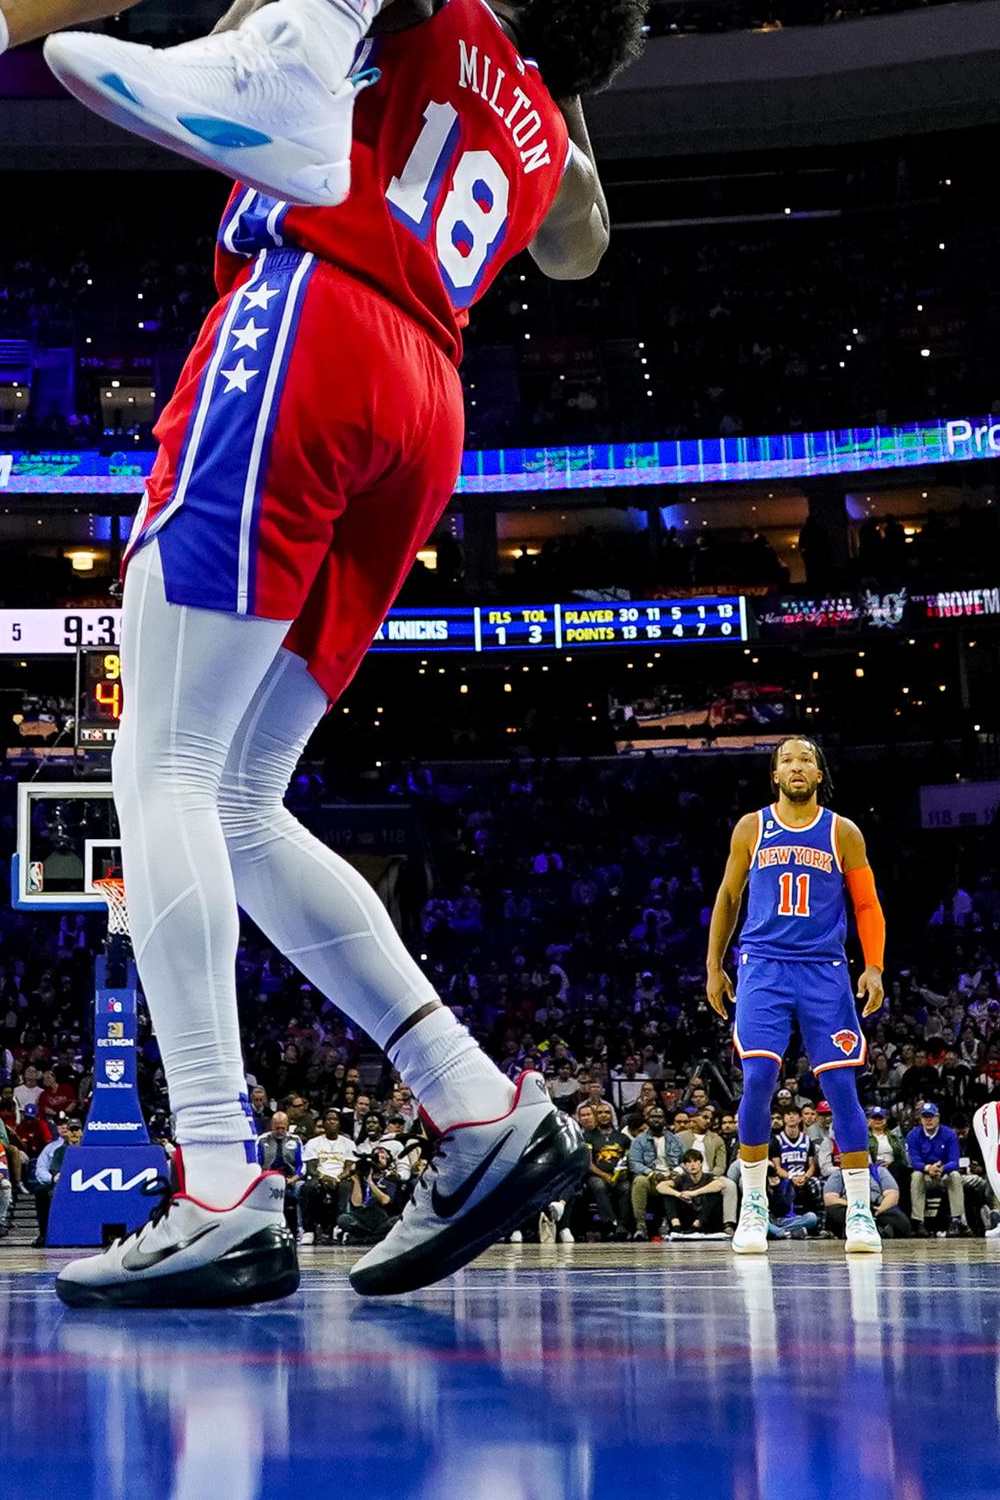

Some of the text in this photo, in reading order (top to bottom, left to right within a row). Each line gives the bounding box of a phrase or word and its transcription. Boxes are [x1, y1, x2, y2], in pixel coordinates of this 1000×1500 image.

[458, 39, 551, 174] MILTON
[385, 100, 512, 300] 18
[12, 623, 21, 641] 5
[64, 616, 122, 647] 9:3
[388, 620, 448, 640] KNICKS
[489, 611, 512, 625] FLS
[521, 610, 547, 623] TOL
[565, 609, 614, 624] PLAYER
[618, 607, 638, 622] 30
[646, 608, 660, 620] 11
[671, 607, 681, 620] 5
[717, 604, 733, 618] 13
[495, 621, 731, 645] 1 3 POINTS 13 15 4 7 0
[104, 654, 120, 679] 9
[96, 683, 119, 718] 4
[757, 845, 833, 874] NEW YORK
[777, 871, 810, 917] 11
[88, 1121, 142, 1130] ticketmaster
